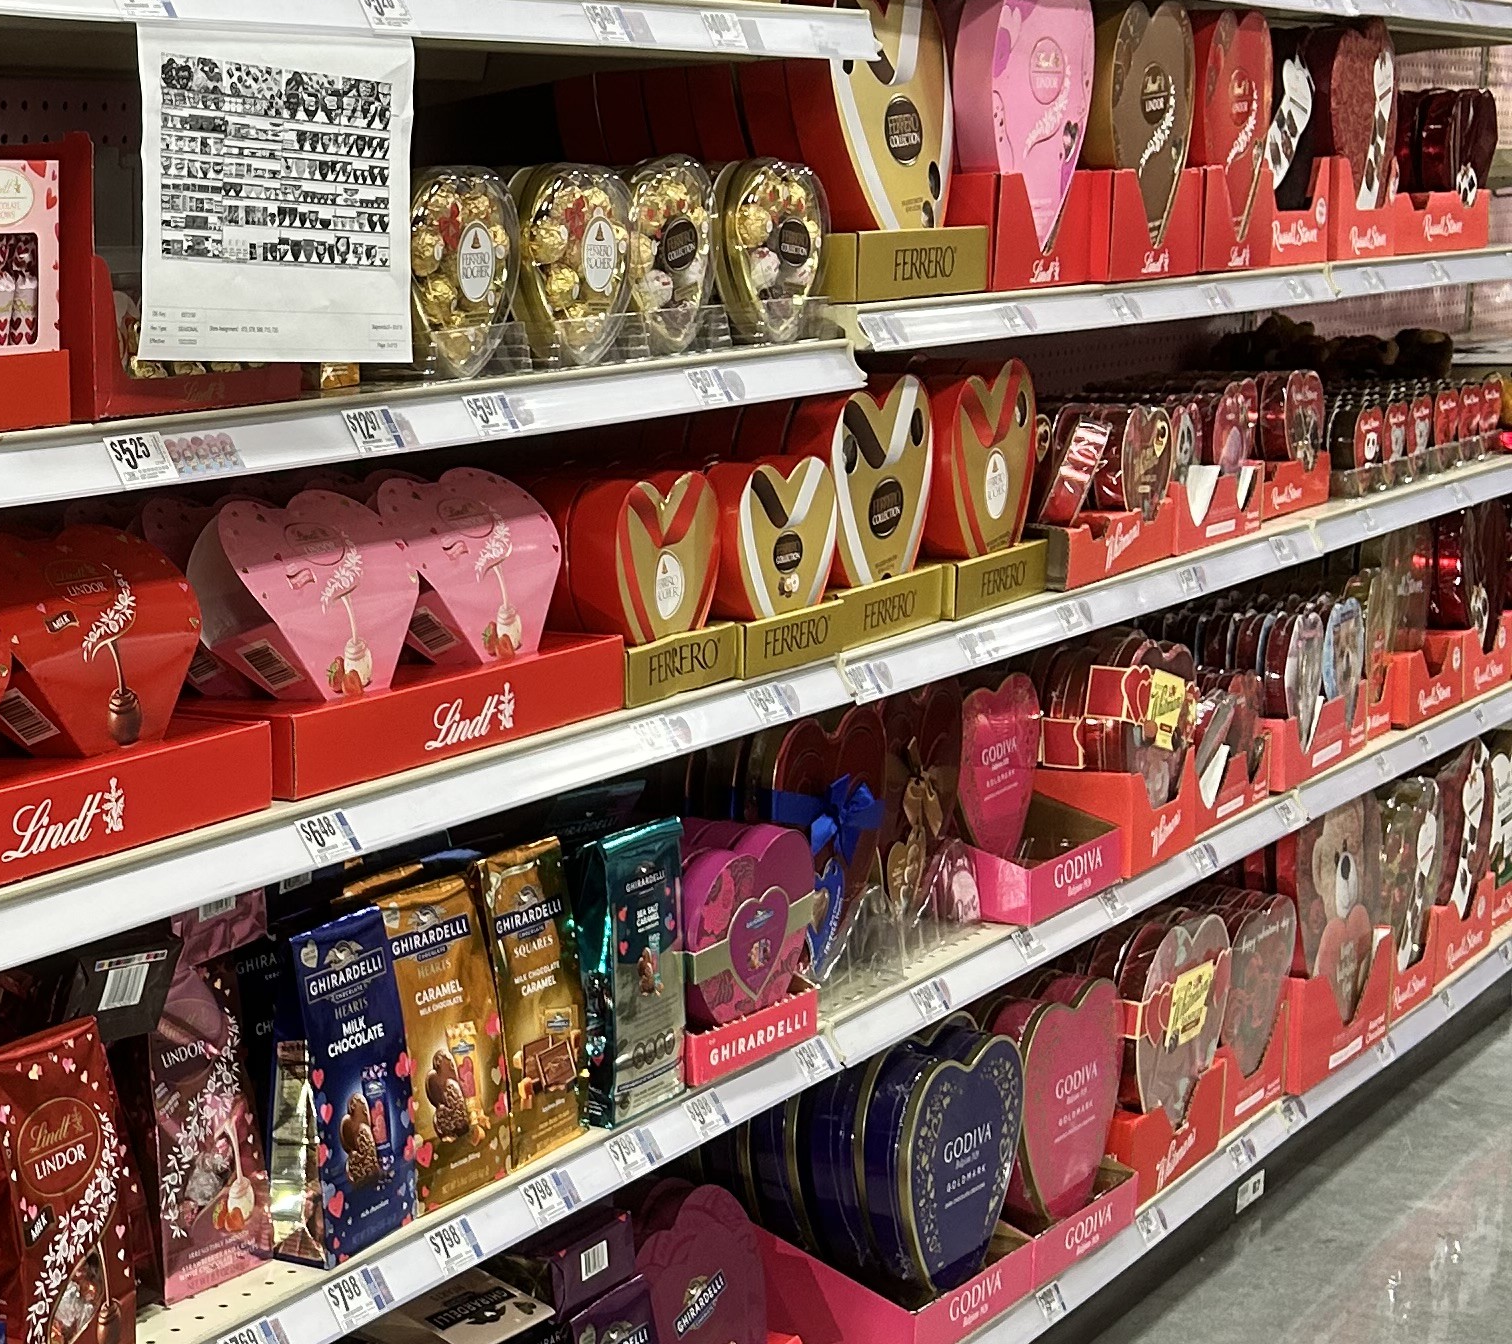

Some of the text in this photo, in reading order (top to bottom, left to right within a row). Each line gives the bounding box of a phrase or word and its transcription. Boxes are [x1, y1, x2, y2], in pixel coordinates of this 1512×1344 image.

[893, 248, 954, 281] FERRERO
[67, 582, 108, 598] LINDOR
[52, 614, 71, 631] MILK
[763, 614, 831, 660] FERRERO
[424, 693, 499, 751] Lindt
[1, 793, 103, 862] Lindt
[1053, 846, 1103, 888] GODIVA
[392, 918, 468, 956] GHIRARDELLI
[513, 935, 553, 958] SQUARES
[310, 955, 384, 996] GHIRARDELLI
[417, 958, 452, 980] HEARTS
[521, 978, 556, 996] CARAMEL
[415, 979, 463, 1005] CARAMEL
[328, 1023, 384, 1057] CHOCOLATE
[342, 1016, 366, 1036] MILK
[943, 1122, 993, 1165] GODIVA
[34, 1144, 86, 1180] LINDOR
[1064, 1205, 1113, 1250] GODIVA
[948, 1274, 1003, 1324] GODIVA
